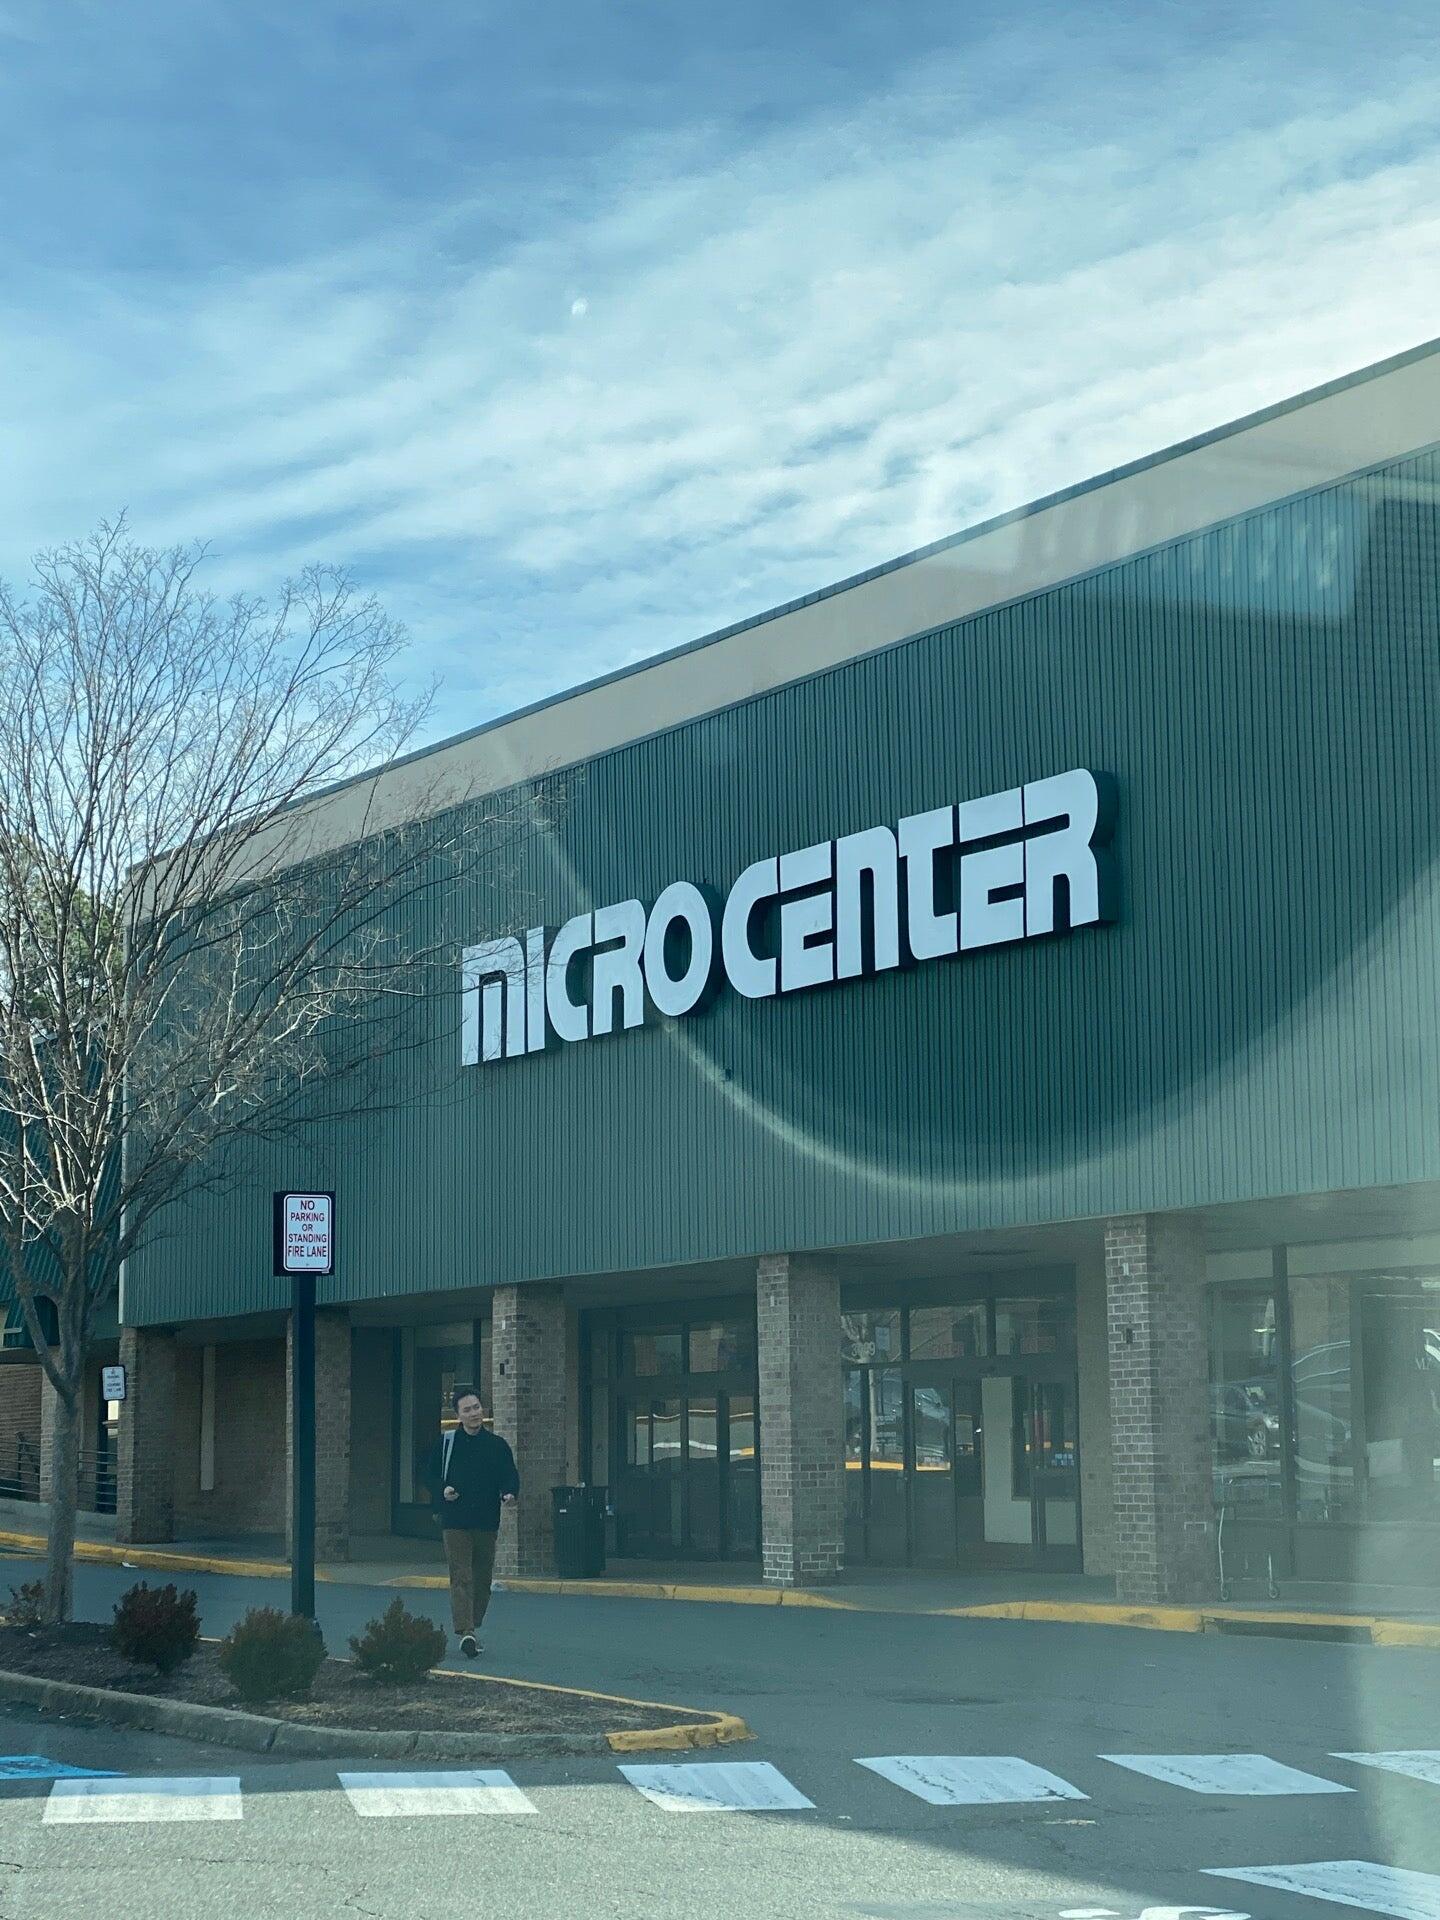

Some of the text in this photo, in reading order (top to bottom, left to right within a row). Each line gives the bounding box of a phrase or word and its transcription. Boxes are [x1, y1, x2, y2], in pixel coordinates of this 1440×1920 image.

[461, 768, 1099, 1067] MICRO CENTER
[300, 1200, 315, 1210] NO
[290, 1212, 325, 1221] PARKING
[301, 1223, 313, 1232] OR
[288, 1233, 327, 1242] STANDING
[287, 1245, 327, 1257] FIRE LANE
